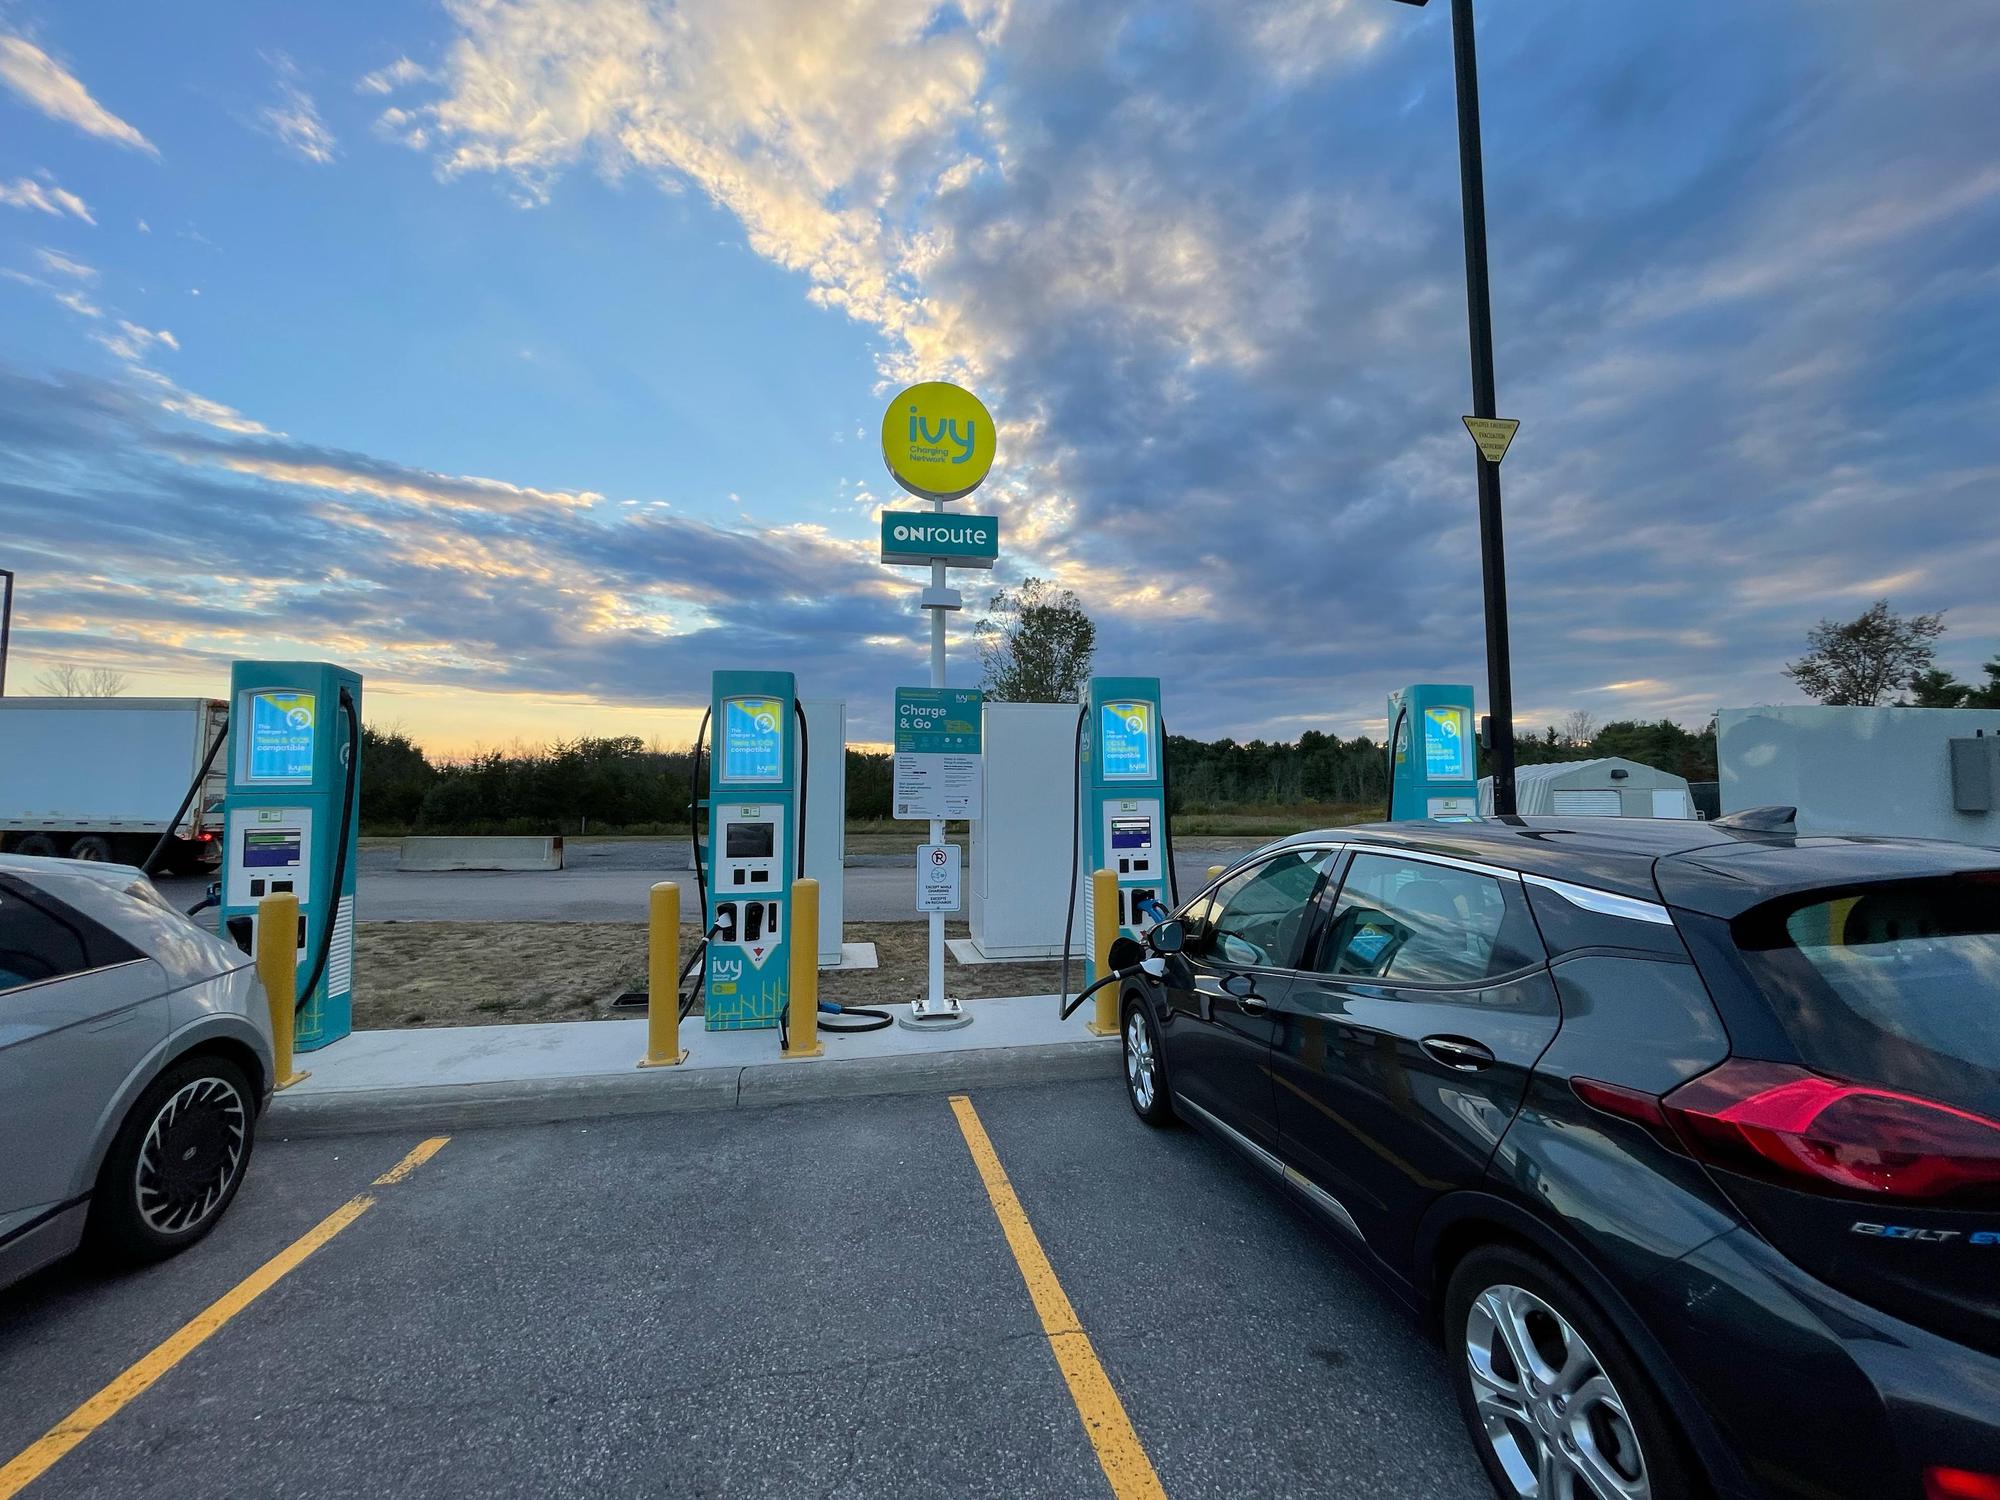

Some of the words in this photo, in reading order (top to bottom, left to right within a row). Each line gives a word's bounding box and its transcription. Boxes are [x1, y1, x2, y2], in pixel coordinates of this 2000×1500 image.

[909, 405, 975, 464] ivy
[910, 446, 949, 456] Charging
[910, 454, 946, 463] Network
[893, 525, 987, 545] ONroute
[900, 704, 947, 718] Charge
[900, 718, 910, 729] &
[913, 718, 931, 729] Go
[257, 744, 306, 752] compatible
[712, 956, 743, 981] ivy
[1851, 1222, 1961, 1242] BOLT
[1969, 1231, 2000, 1245] E
